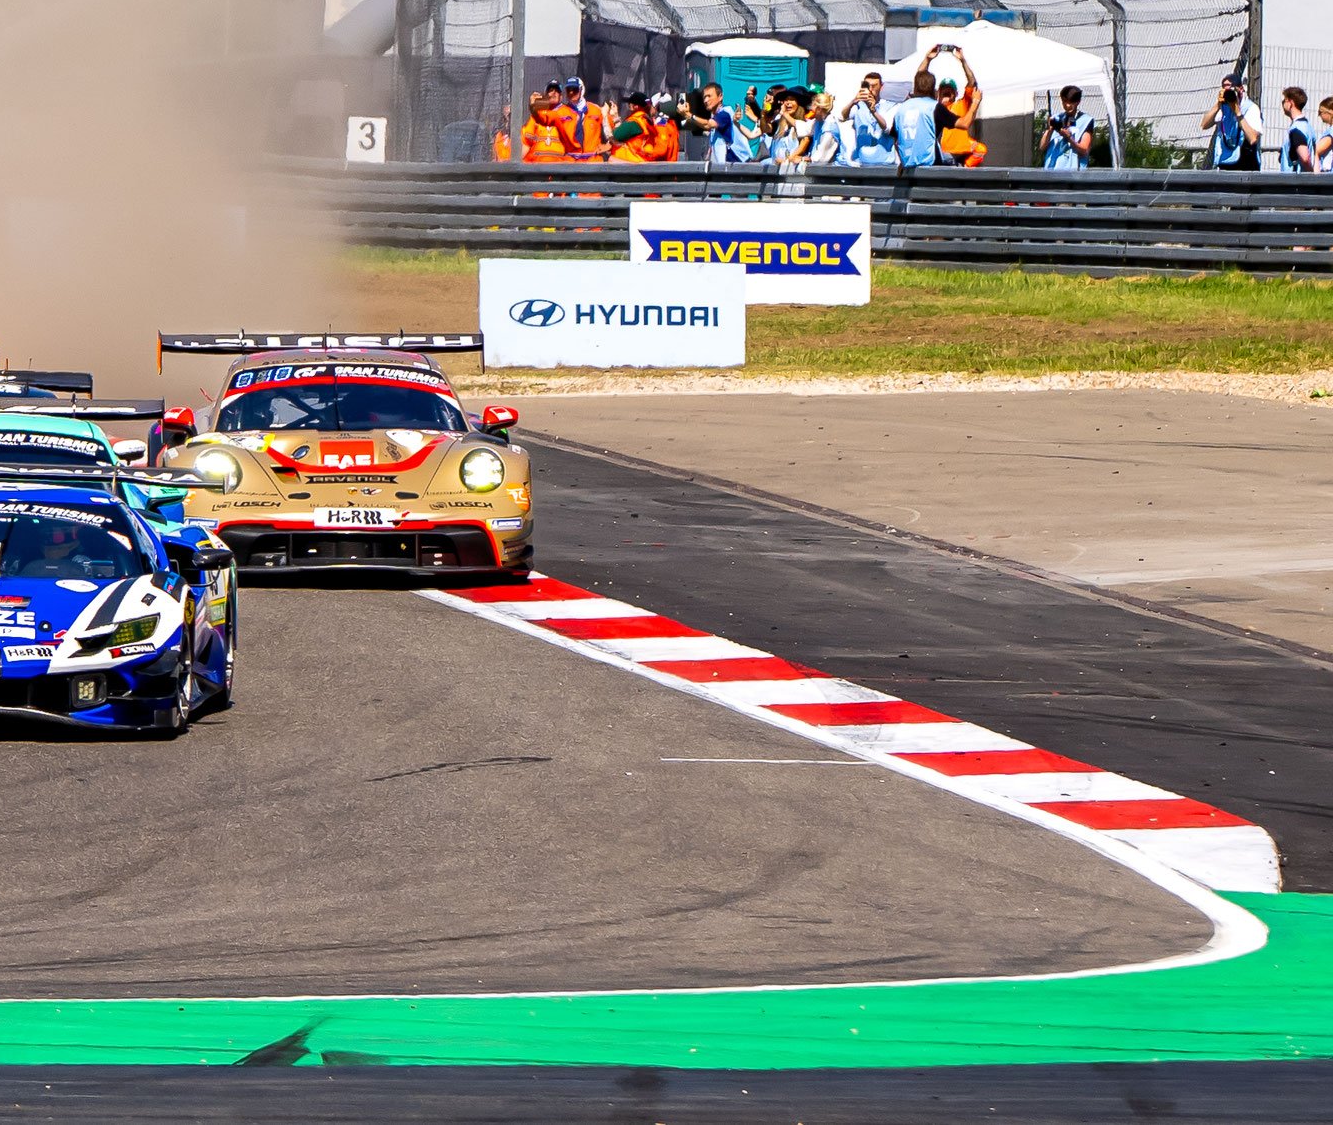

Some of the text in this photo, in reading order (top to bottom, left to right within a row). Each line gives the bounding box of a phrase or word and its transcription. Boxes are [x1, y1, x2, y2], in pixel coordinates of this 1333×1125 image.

[359, 122, 375, 150] 3
[661, 241, 840, 265] RAVENOL
[576, 303, 719, 327] HYUNDAI
[31, 506, 106, 524] TURISMO
